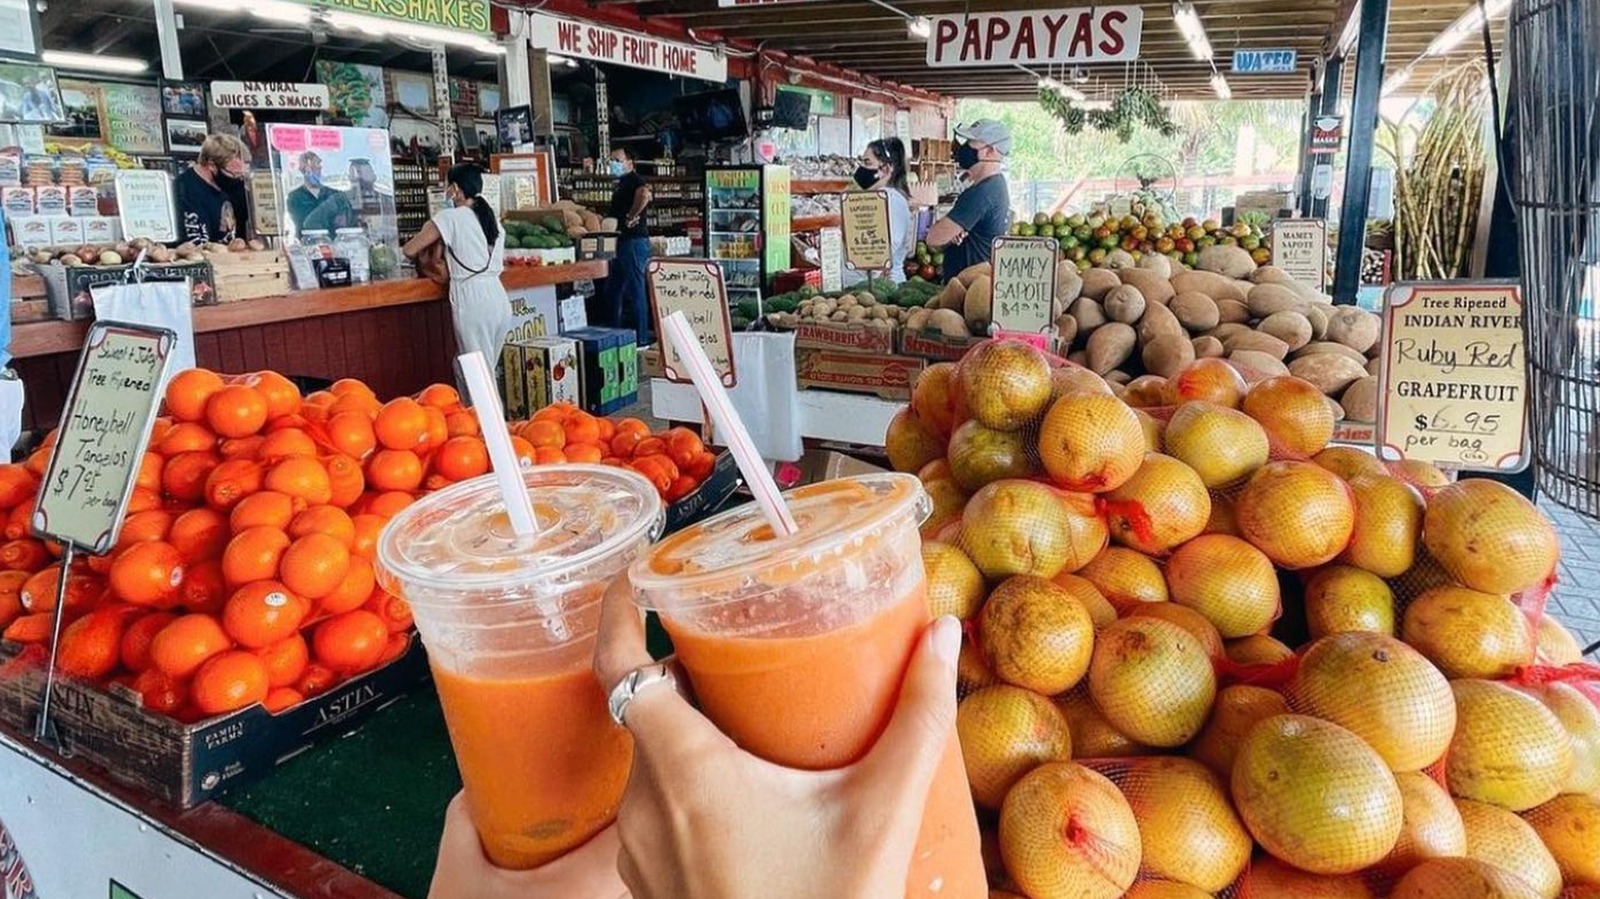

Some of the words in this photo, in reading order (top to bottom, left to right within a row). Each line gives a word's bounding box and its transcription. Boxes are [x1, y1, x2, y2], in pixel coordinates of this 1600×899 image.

[935, 10, 1128, 62] PAPAYAS
[558, 21, 582, 53] WE
[587, 27, 618, 59] SHIP
[622, 35, 658, 68] FRUIT
[662, 44, 697, 74] HOME
[1237, 51, 1293, 71] WATER
[243, 81, 299, 93] NATURAL
[216, 94, 259, 107] JUICES
[265, 95, 274, 107] &
[278, 95, 322, 108] SNACKS
[999, 257, 1050, 278] MAMEY
[994, 281, 1050, 302] SAPOTE
[1421, 297, 1450, 309] Tree
[1454, 296, 1507, 312] Ripened
[1403, 314, 1466, 328] INDIAN
[1470, 315, 1522, 329] RIVER
[799, 325, 861, 346] TRAWBERRIES
[1394, 338, 1457, 374] Ruby
[1465, 341, 1517, 369] Red
[1397, 381, 1519, 402] GRAPEFRUIT
[71, 399, 136, 447] Honeybell
[1404, 434, 1439, 451] per
[1449, 435, 1483, 451] bag
[53, 683, 93, 721] STIN
[314, 683, 379, 726] ASTIN
[205, 720, 244, 743] FAMILY
[208, 730, 243, 750] FARMS
